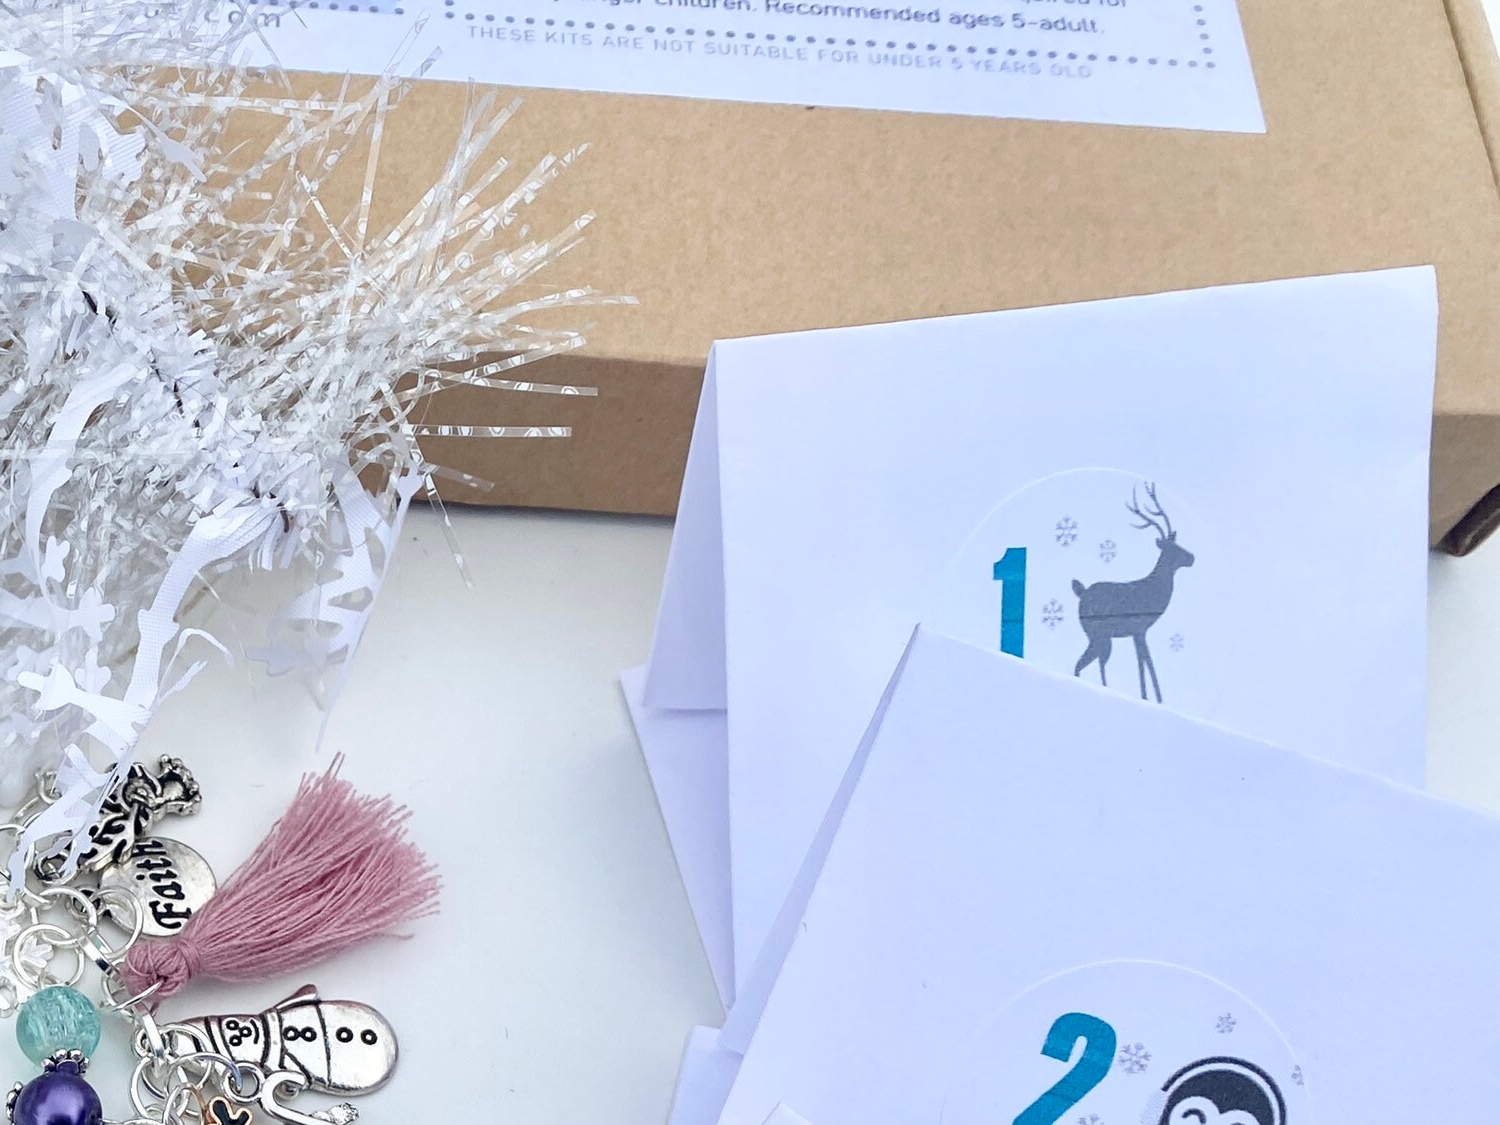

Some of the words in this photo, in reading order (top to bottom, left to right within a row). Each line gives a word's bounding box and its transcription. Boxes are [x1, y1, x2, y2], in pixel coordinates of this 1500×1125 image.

[765, 0, 941, 24] Recommended
[949, 12, 1005, 29] ages
[467, 25, 536, 42] THESE
[545, 31, 593, 46] KITS
[602, 35, 645, 50] ARE
[654, 38, 695, 52] NOT
[704, 41, 809, 61] SUITABLE
[817, 48, 859, 65] FOR
[867, 52, 942, 69] UNDER
[970, 59, 1042, 76] YEARS
[1050, 62, 1093, 79] OLD
[993, 547, 1027, 659] 1
[133, 839, 193, 930] Faith
